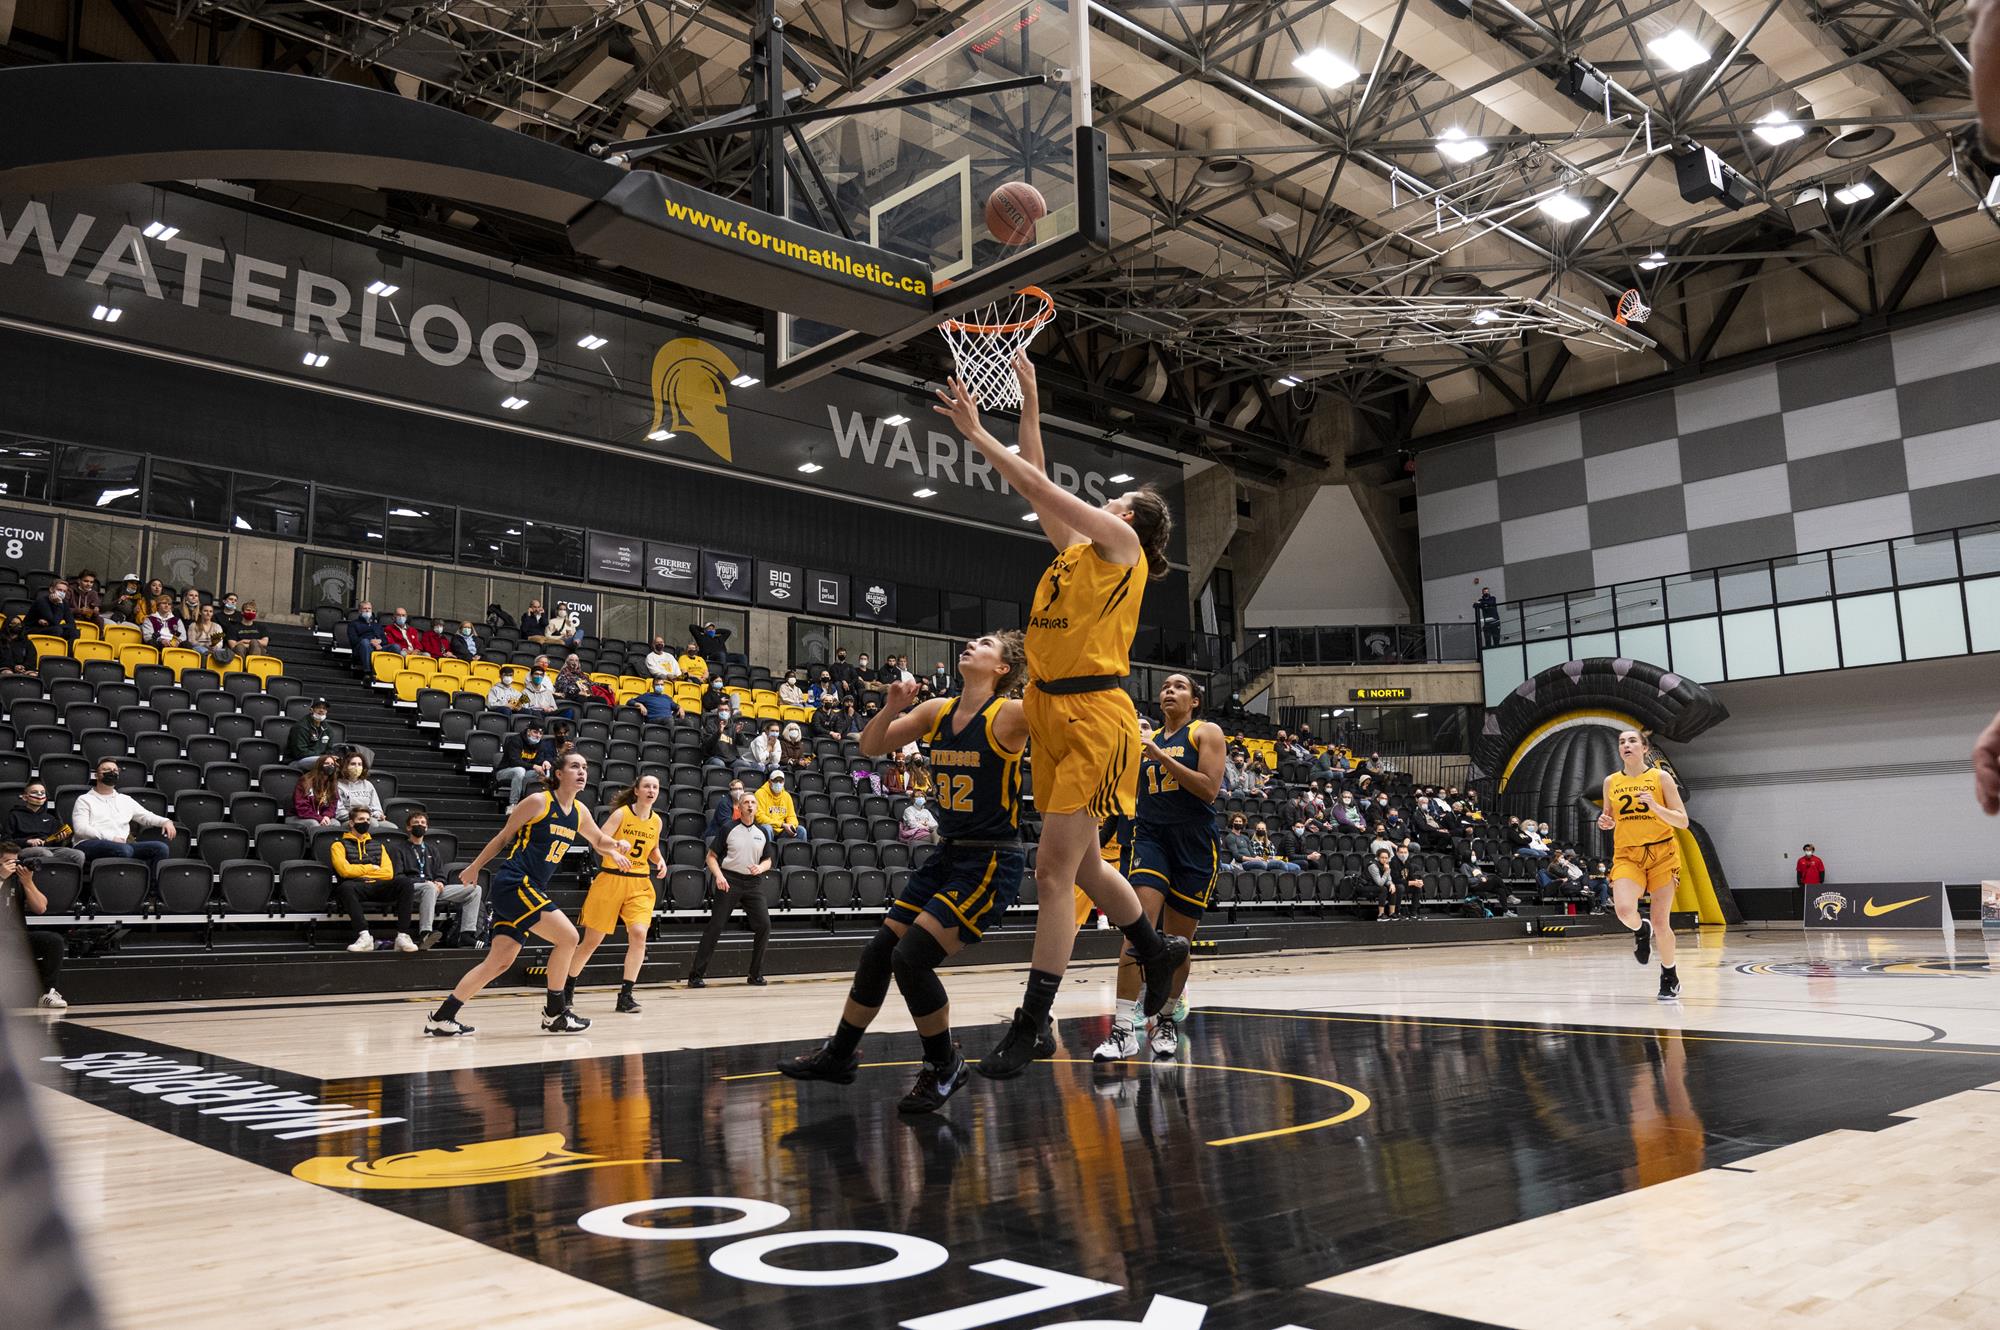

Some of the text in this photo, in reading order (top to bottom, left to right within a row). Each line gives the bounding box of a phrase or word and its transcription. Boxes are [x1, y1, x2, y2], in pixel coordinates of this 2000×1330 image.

[996, 192, 1025, 225] Wilson
[665, 199, 927, 296] www.forumathletic.ca
[0, 200, 538, 382] WATERLOO
[827, 405, 1107, 508] WARRRS
[6, 539, 23, 559] 8
[655, 557, 691, 569] CHERREY
[718, 565, 737, 578] YOUTH
[769, 569, 791, 583] BIO
[769, 581, 791, 589] STEEL
[568, 611, 580, 628] 6
[1370, 689, 1405, 697] NORTH
[1146, 764, 1180, 794] 12
[936, 772, 974, 812] 32
[545, 840, 570, 864] 15
[629, 838, 646, 858] 5
